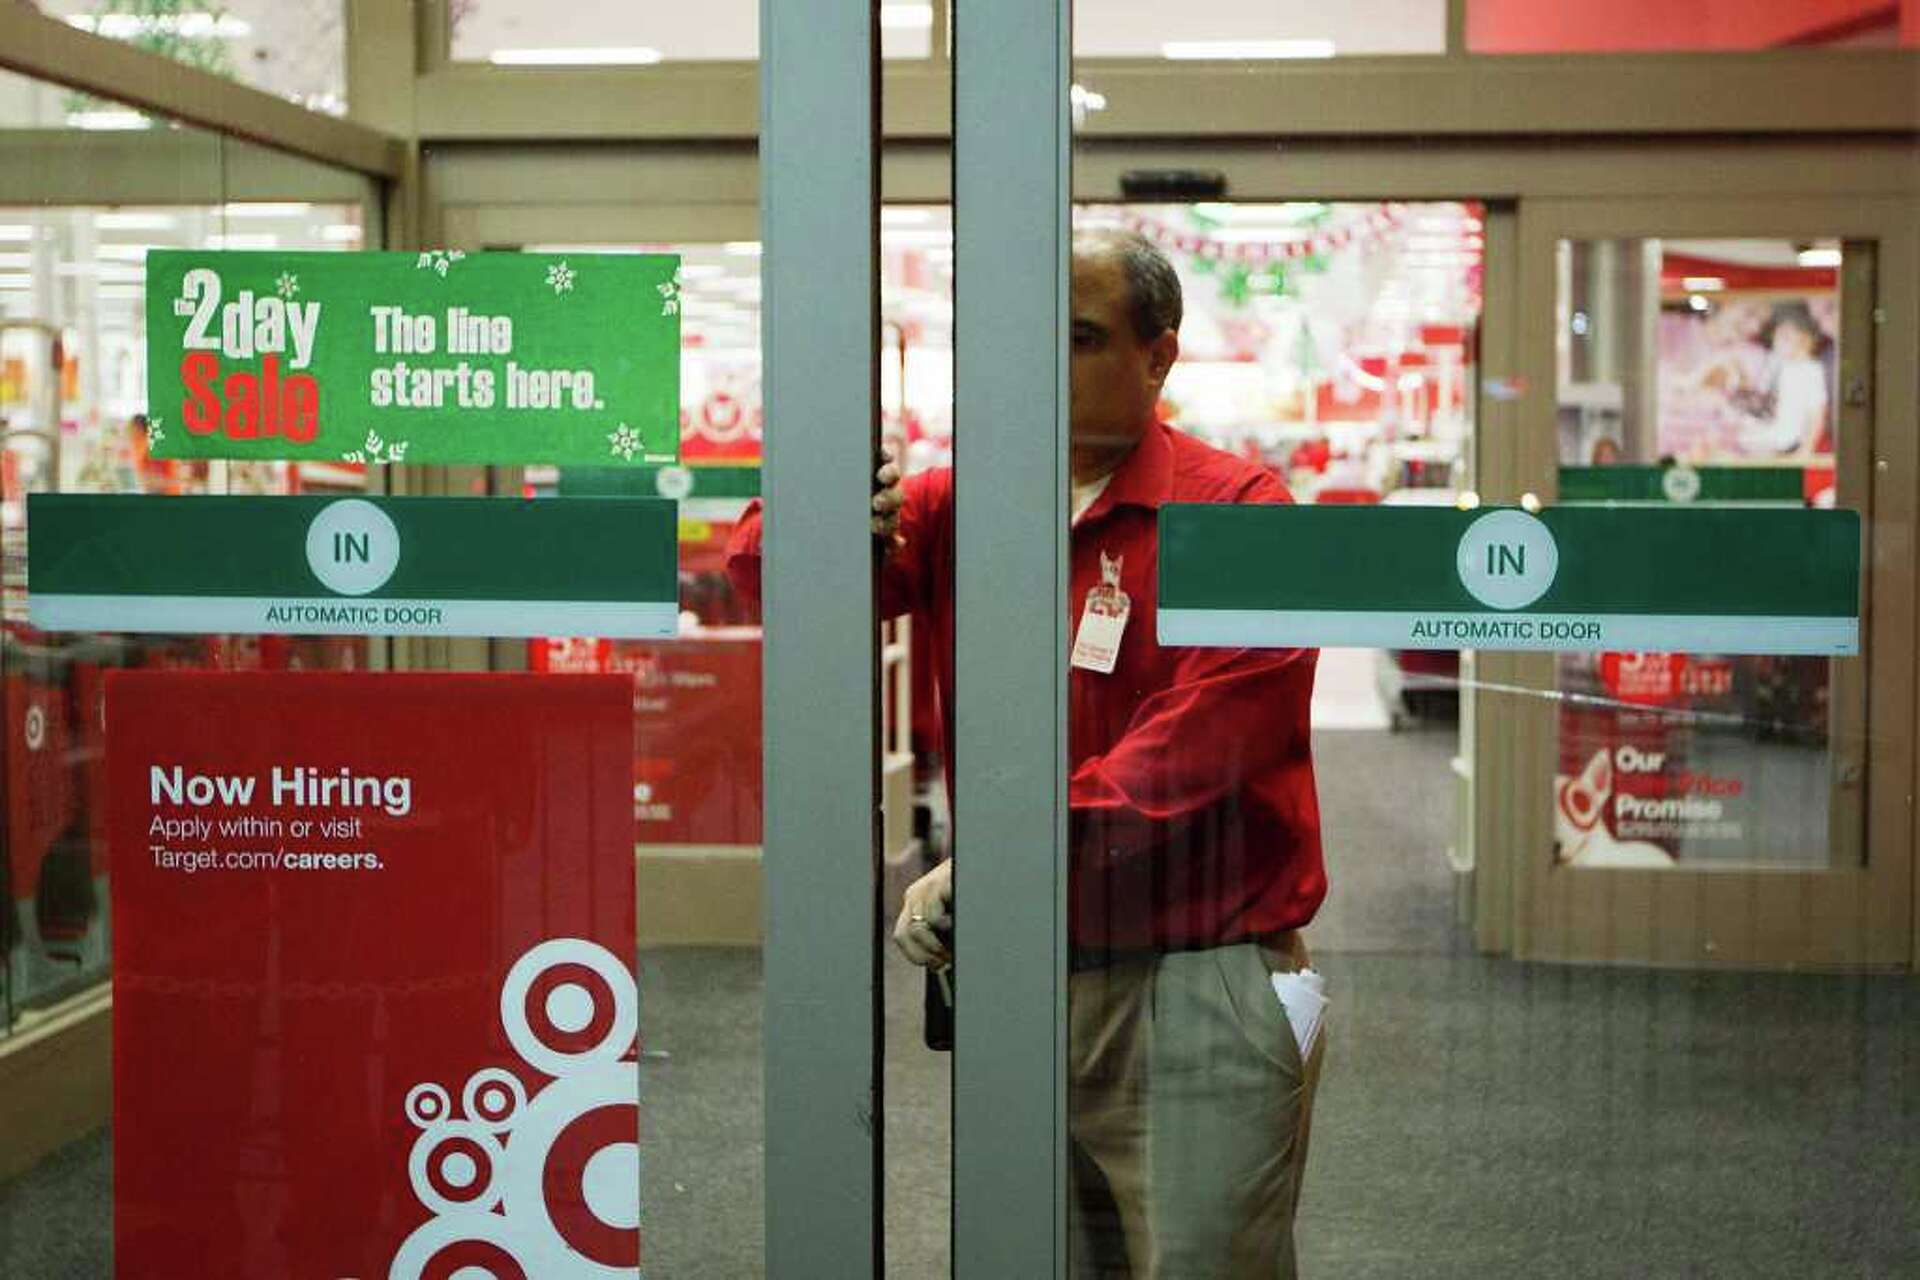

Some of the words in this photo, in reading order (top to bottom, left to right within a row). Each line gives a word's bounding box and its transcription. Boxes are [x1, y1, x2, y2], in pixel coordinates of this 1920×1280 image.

[370, 306, 435, 354] The
[447, 306, 512, 355] line
[180, 349, 320, 444] Sale
[370, 362, 495, 409] starts
[506, 362, 604, 410] here.
[333, 532, 370, 563] IN
[1486, 543, 1526, 575] IN
[265, 605, 378, 625] AUTOMATIC
[384, 606, 442, 626] DOOR
[1411, 620, 1533, 640] AUTOMATIC
[1540, 620, 1602, 641] DOOR
[1616, 745, 1665, 773] Our
[150, 765, 256, 806] Now
[271, 766, 413, 816] Hiring
[149, 814, 213, 842] Apply
[219, 815, 283, 839] within
[290, 823, 313, 839] or
[320, 816, 362, 839] visit
[149, 845, 385, 873] Target.com/careers.
